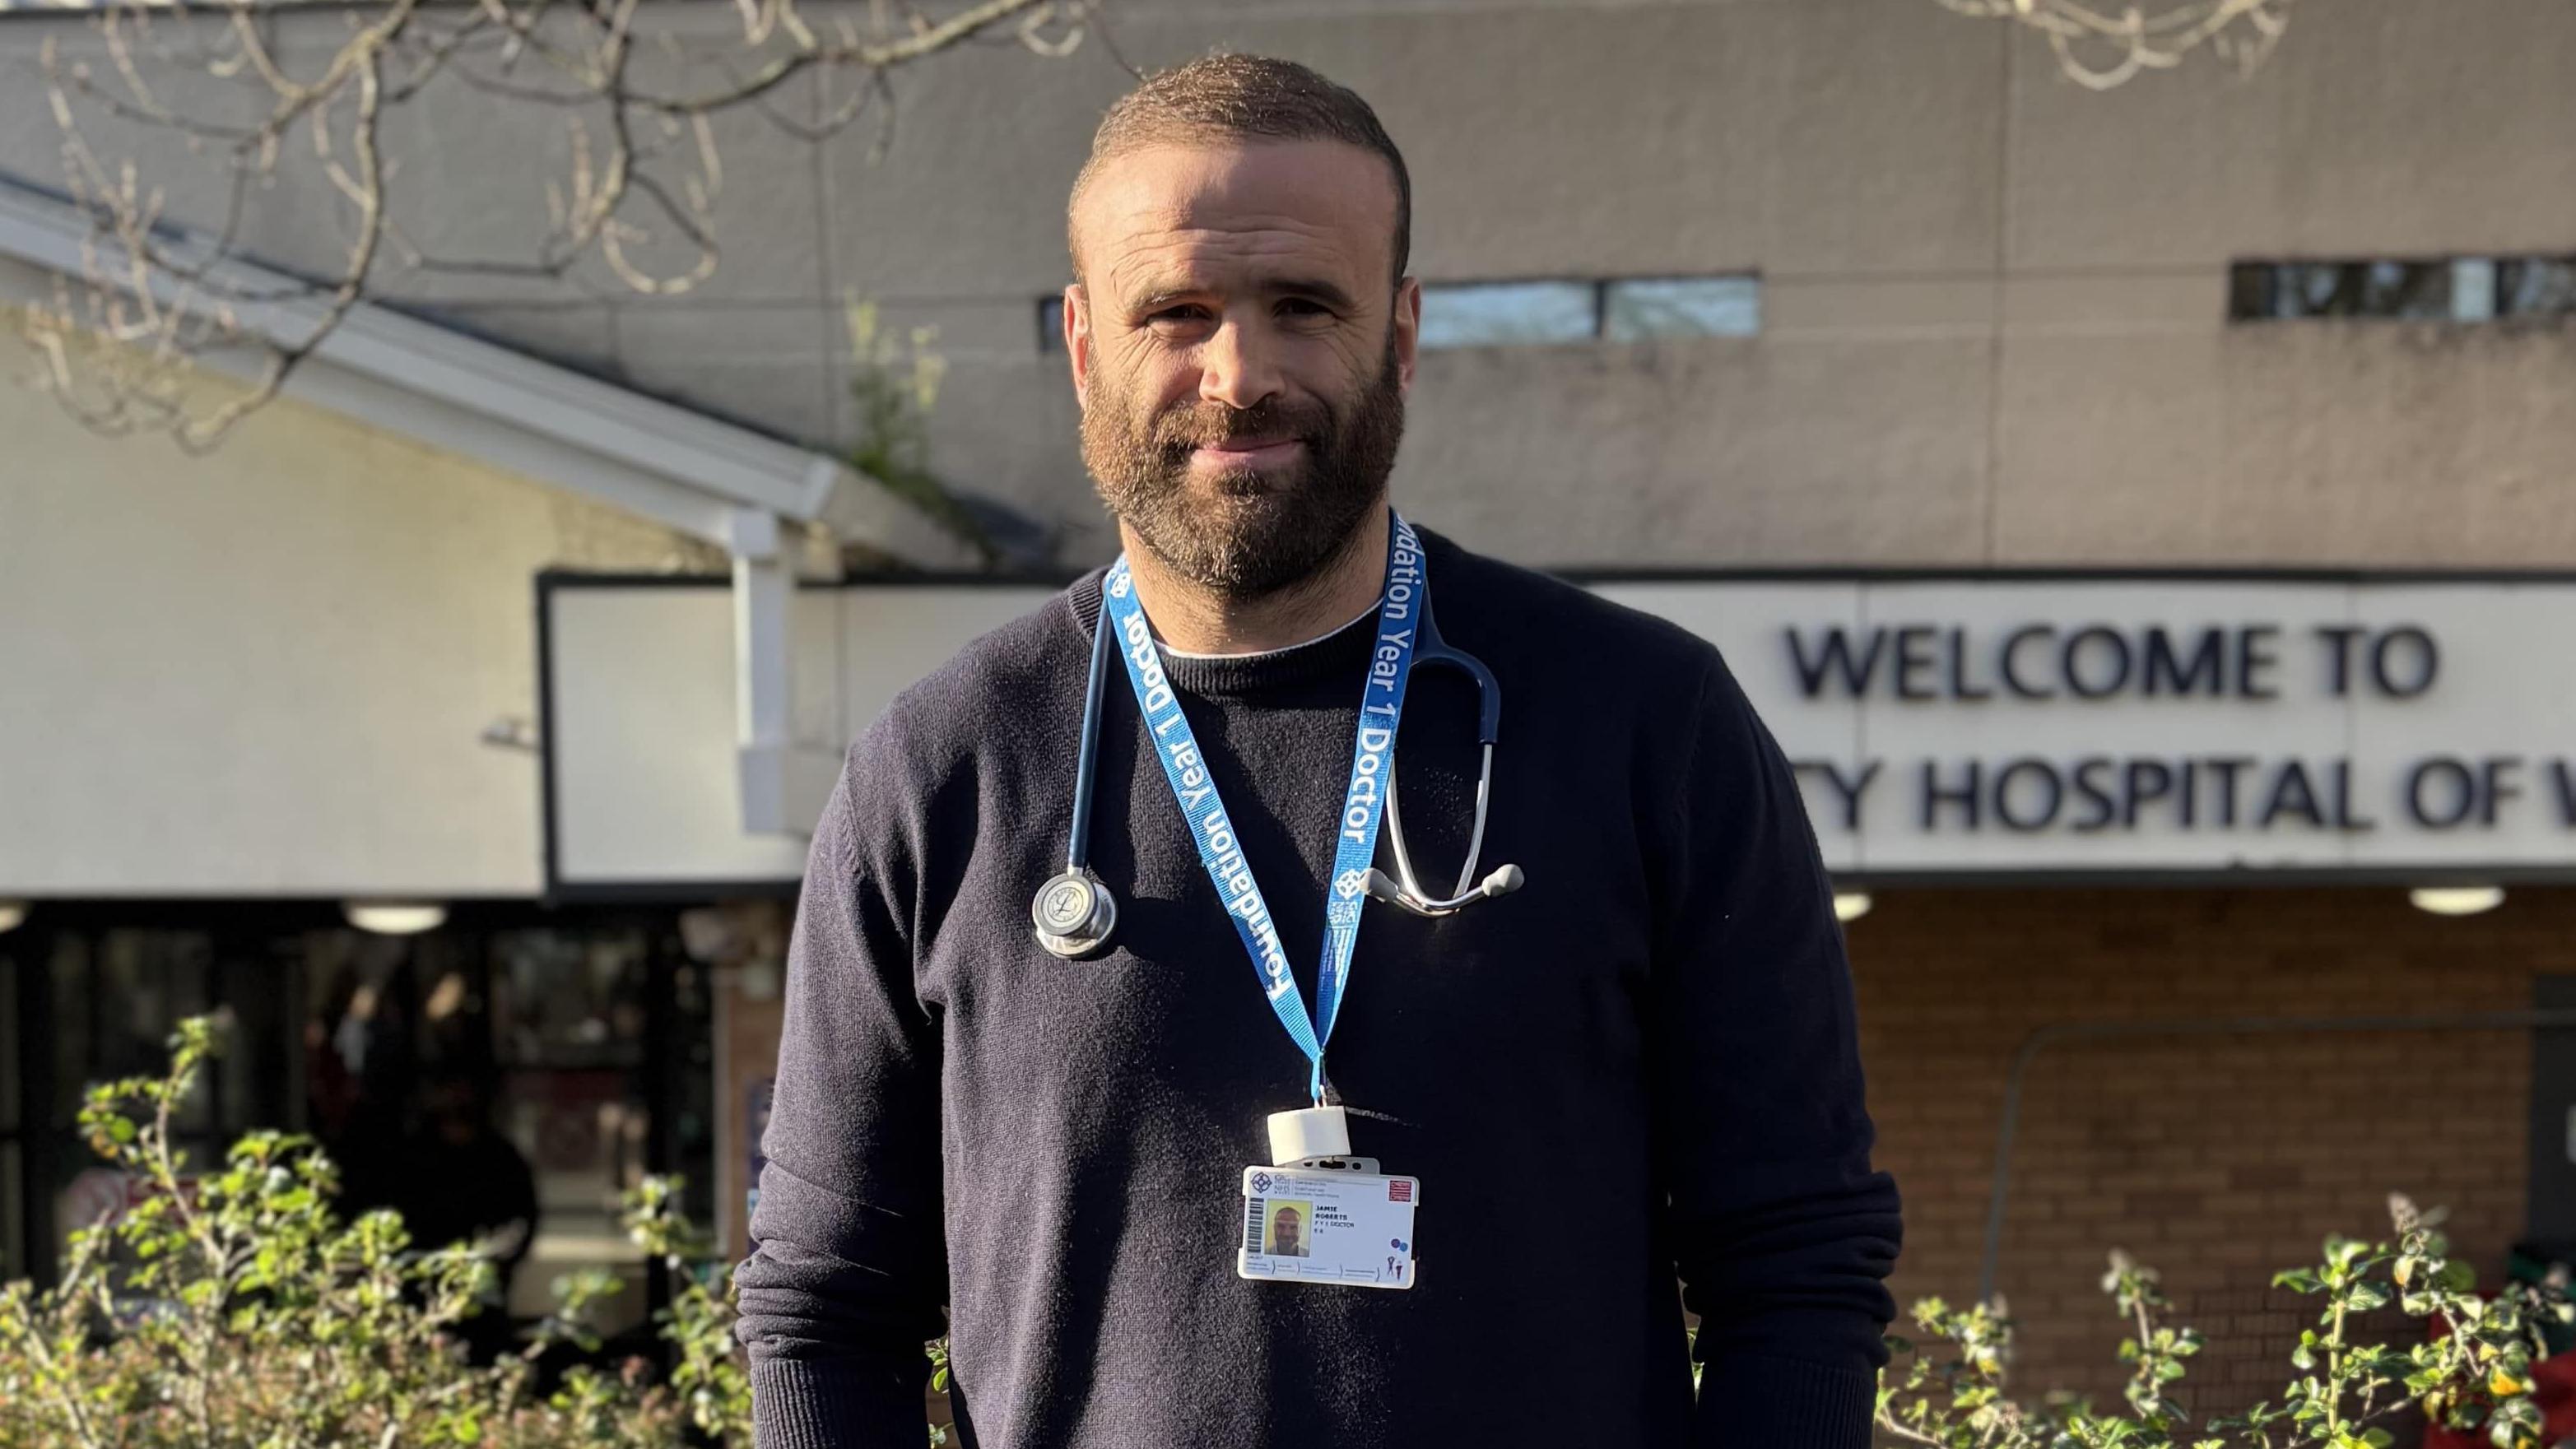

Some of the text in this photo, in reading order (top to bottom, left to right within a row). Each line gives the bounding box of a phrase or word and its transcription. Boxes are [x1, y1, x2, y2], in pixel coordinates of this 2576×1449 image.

[1343, 512, 1425, 844] ndation Year 1 Doctor
[1783, 623, 2440, 701] WELCOME TO
[1123, 610, 1291, 1001] Foundation Year 1 Doctor
[1919, 757, 2374, 834] HOSPITAL
[2403, 755, 2522, 833] OF
[1315, 1213, 1348, 1221] ROBERTS
